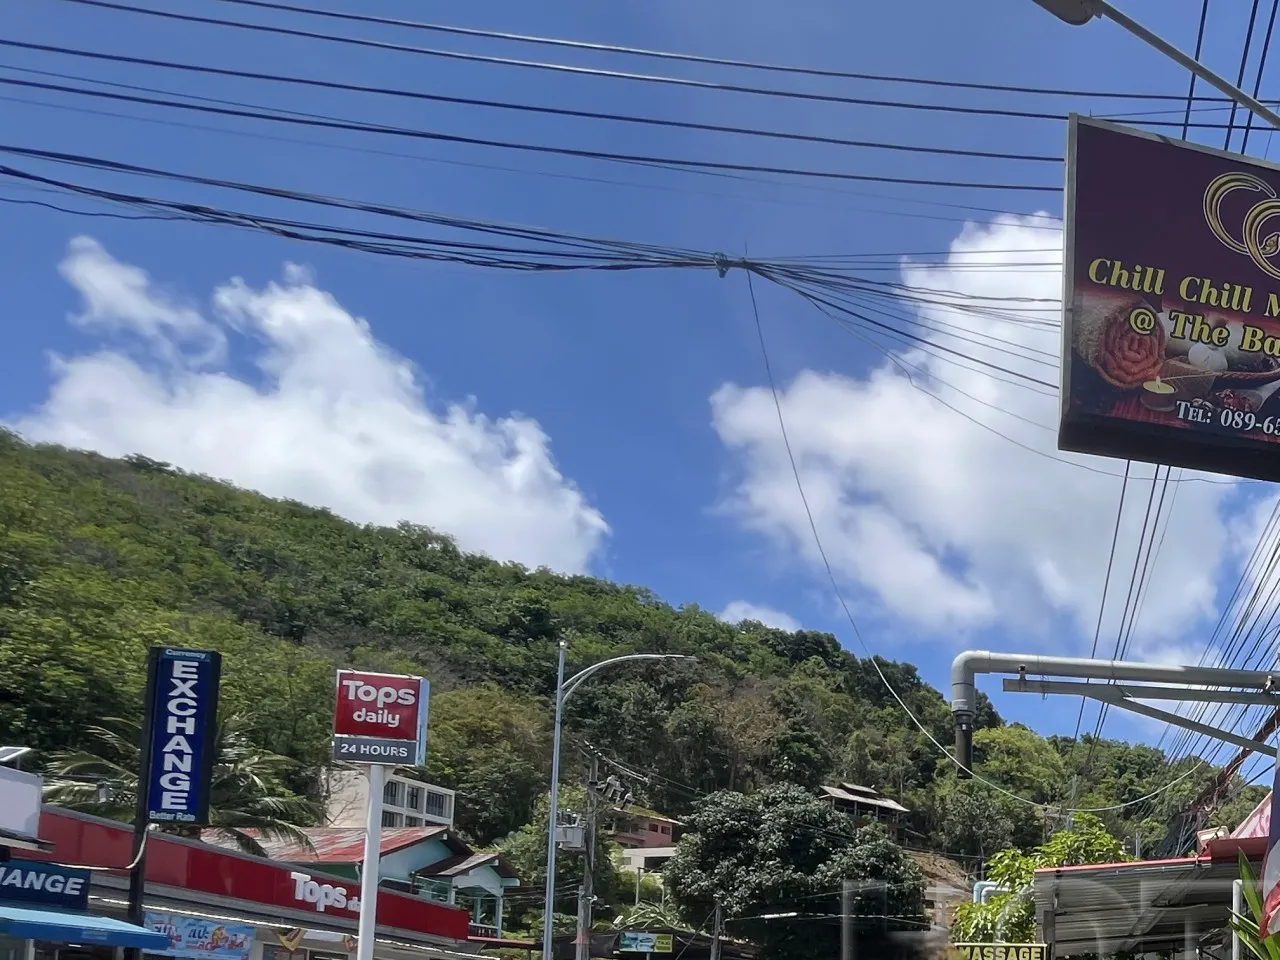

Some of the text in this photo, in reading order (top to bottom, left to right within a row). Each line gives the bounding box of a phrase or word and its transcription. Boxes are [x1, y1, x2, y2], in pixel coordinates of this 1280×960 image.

[1087, 257, 1165, 295] Chill
[1179, 276, 1252, 313] Chill
[1129, 308, 1155, 335] @
[1169, 310, 1230, 347] The
[342, 680, 415, 708] Tops
[352, 707, 400, 728] daily
[159, 660, 199, 810] EXCHANGE
[340, 743, 408, 757] 24 HOURS
[149, 810, 196, 822] Better Rate
[290, 871, 347, 912] Tops
